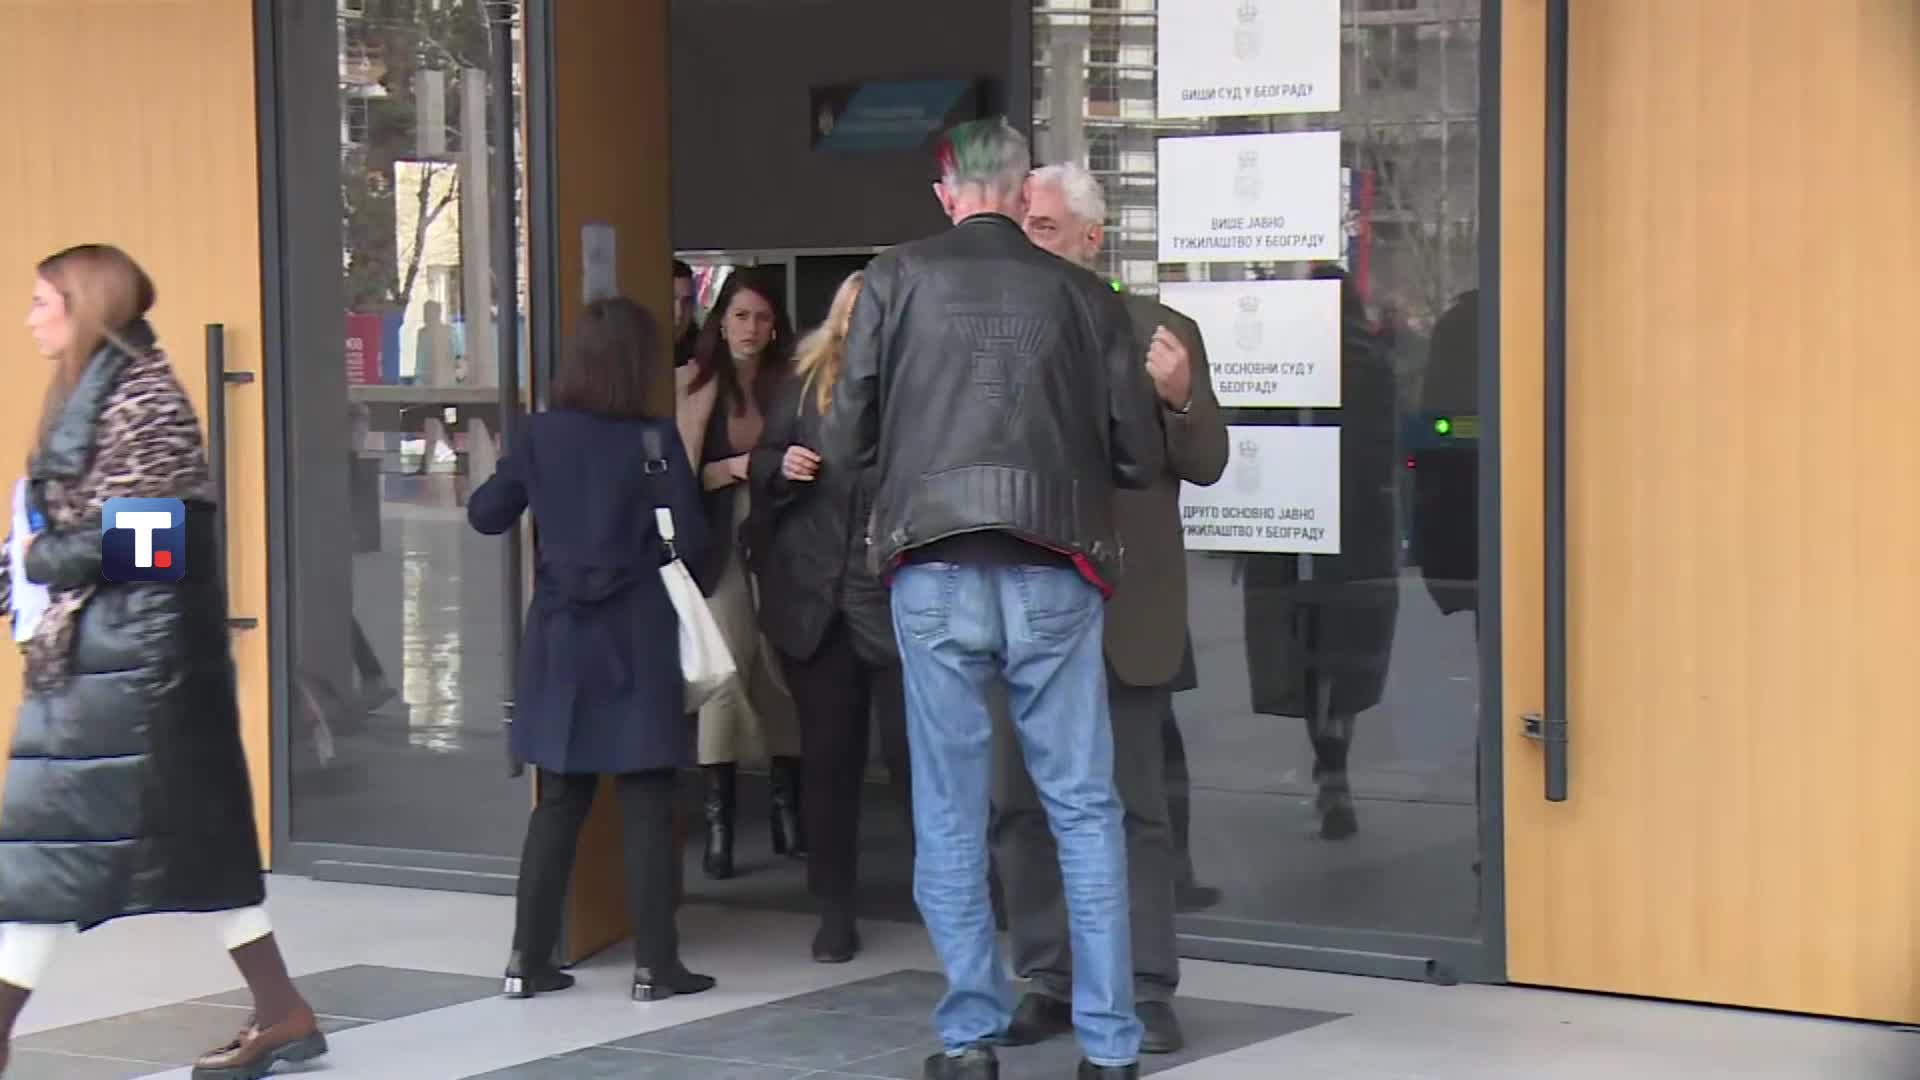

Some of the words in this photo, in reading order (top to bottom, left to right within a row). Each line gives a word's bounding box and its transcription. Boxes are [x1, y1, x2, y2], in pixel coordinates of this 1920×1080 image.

[1218, 86, 1242, 101] СУД
[1244, 86, 1251, 98] У
[1254, 83, 1313, 99] БЕОГРАДУ
[1211, 217, 1244, 230] ВИШЕ
[1247, 215, 1285, 229] ЈАВНО
[1173, 235, 1251, 249] ТУЖИЛАШТВО
[1255, 234, 1263, 247] У
[1265, 233, 1325, 248] БЕОГРАДУ
[1224, 362, 1279, 375] ОСНОВНИ
[1281, 362, 1305, 376] СУД
[1307, 362, 1315, 375] У
[1219, 381, 1279, 395] БЕОГРАДУ
[1183, 506, 1219, 519] ДРУГО
[1222, 507, 1275, 520] ОСНОВНО
[1279, 508, 1315, 521] ЈАВНО
[1255, 526, 1264, 538] У
[1265, 526, 1326, 541] БЕОГРАДУ
